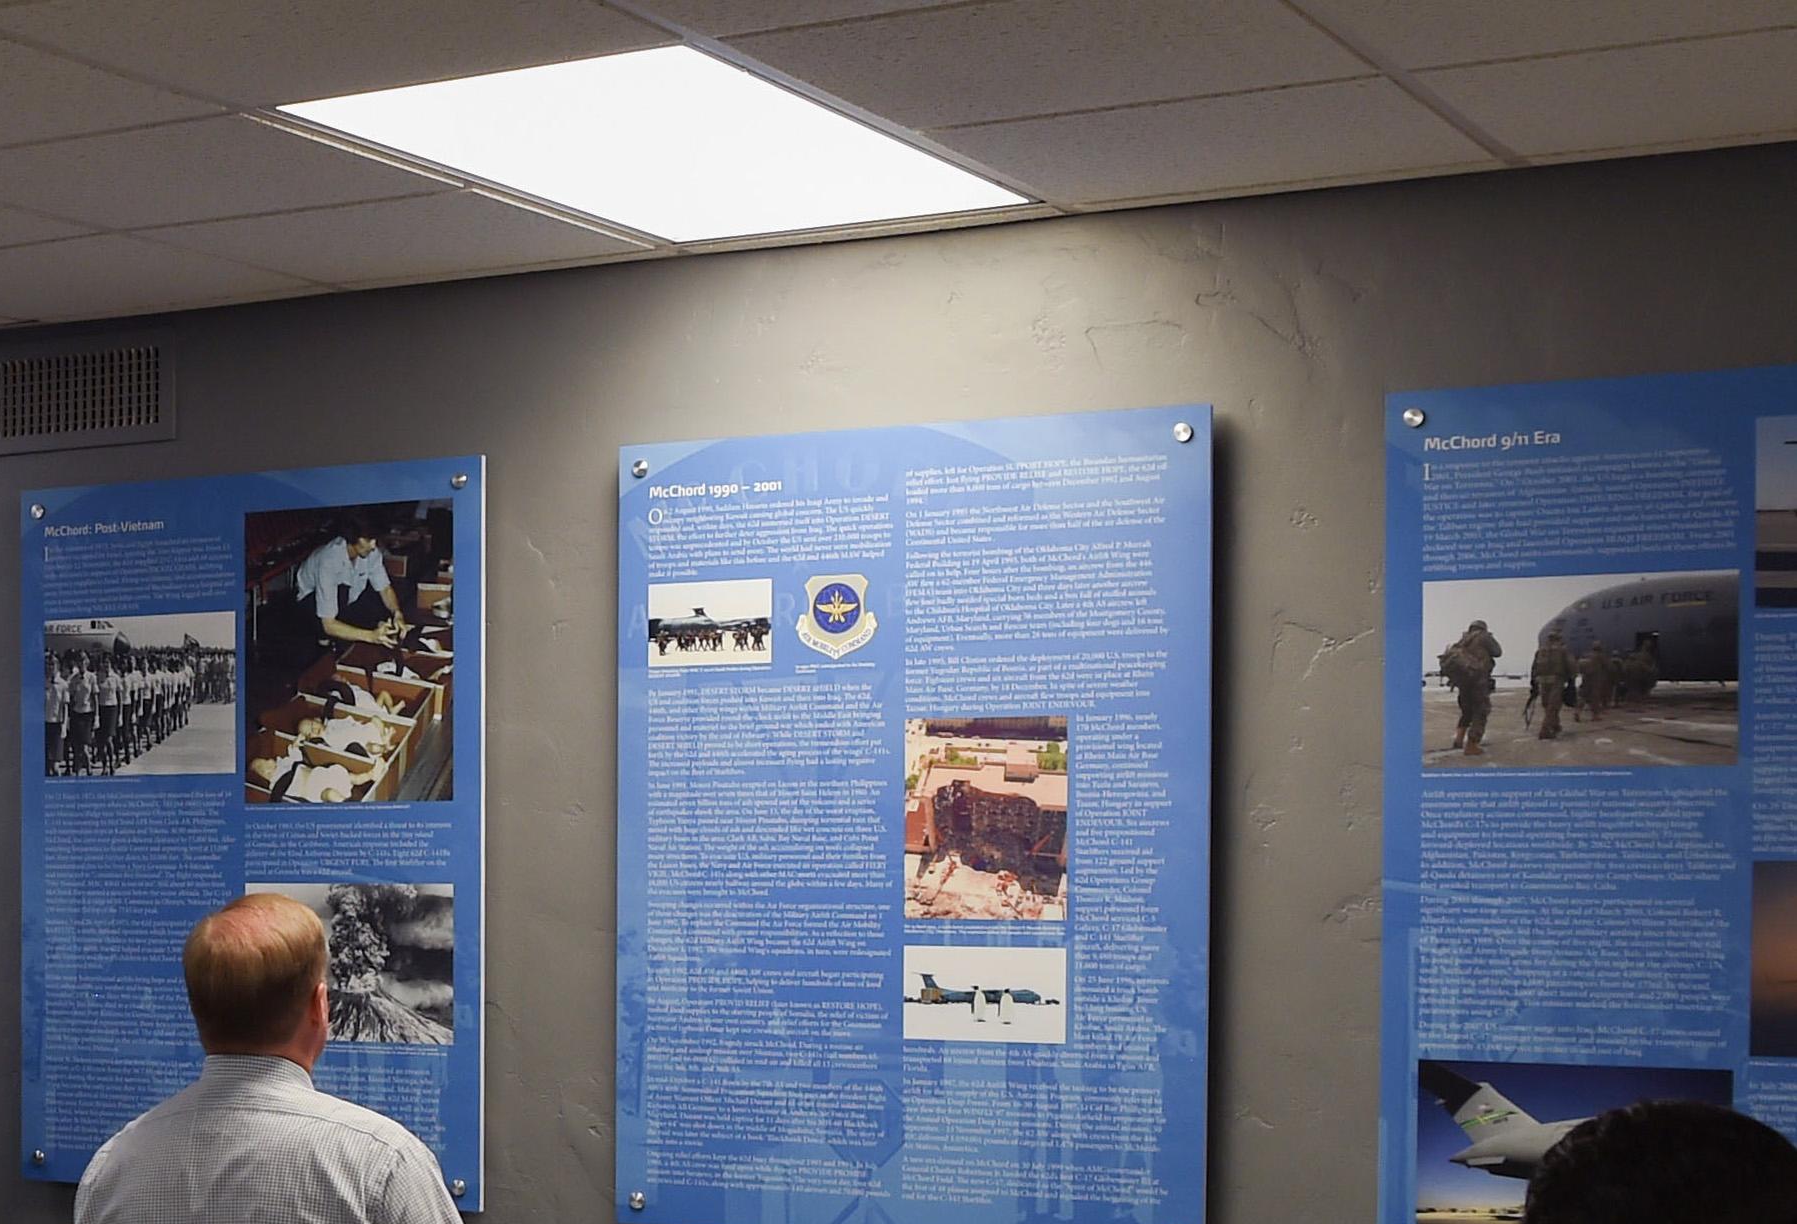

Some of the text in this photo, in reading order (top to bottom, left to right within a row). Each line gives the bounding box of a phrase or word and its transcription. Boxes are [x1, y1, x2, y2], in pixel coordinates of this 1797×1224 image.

[1425, 431, 1560, 451] McChord 9/11 Era
[650, 482, 706, 498] McChord
[710, 485, 738, 497] 1990
[753, 481, 782, 492] 2001
[45, 520, 164, 537] McChord: Post-Vietnam
